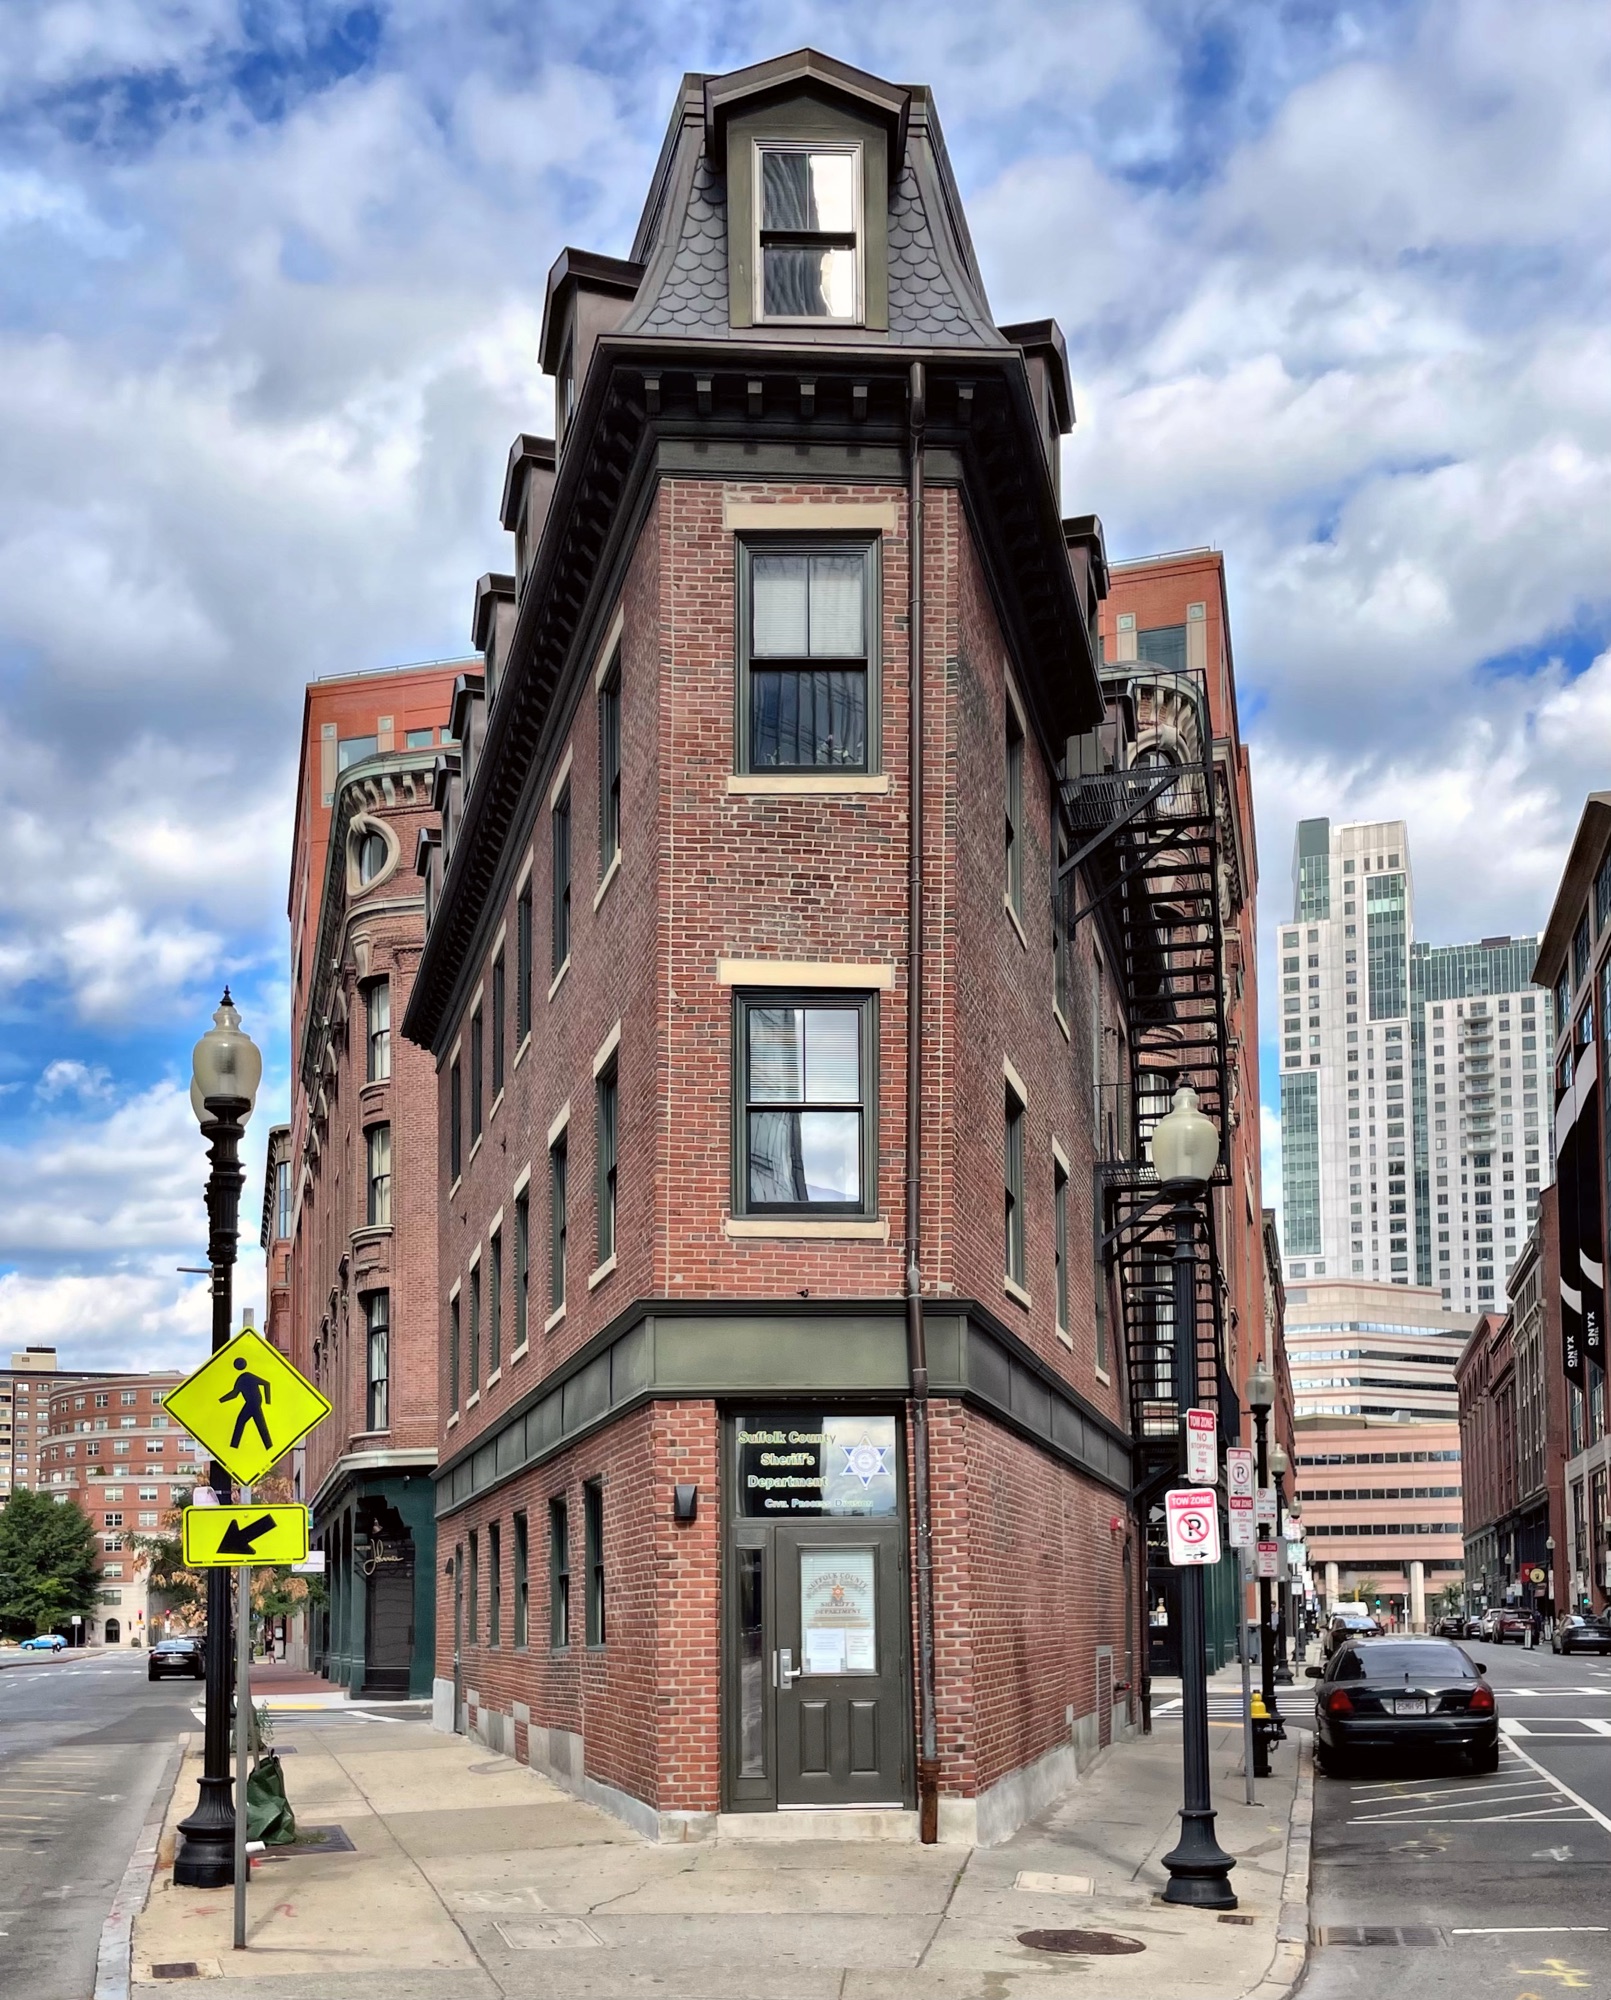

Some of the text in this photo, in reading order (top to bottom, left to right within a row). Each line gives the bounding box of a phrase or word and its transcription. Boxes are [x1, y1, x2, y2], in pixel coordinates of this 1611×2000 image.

[1587, 1311, 1595, 1346] ONYX
[1201, 1416, 1214, 1429] ZONE
[738, 1431, 836, 1444] Suffolk County
[1197, 1433, 1207, 1442] NO
[760, 1453, 816, 1466] Sheriff's
[747, 1475, 829, 1490] Department
[1171, 1495, 1211, 1505] TOW ZONE
[840, 1572, 869, 1590] COUNTY
